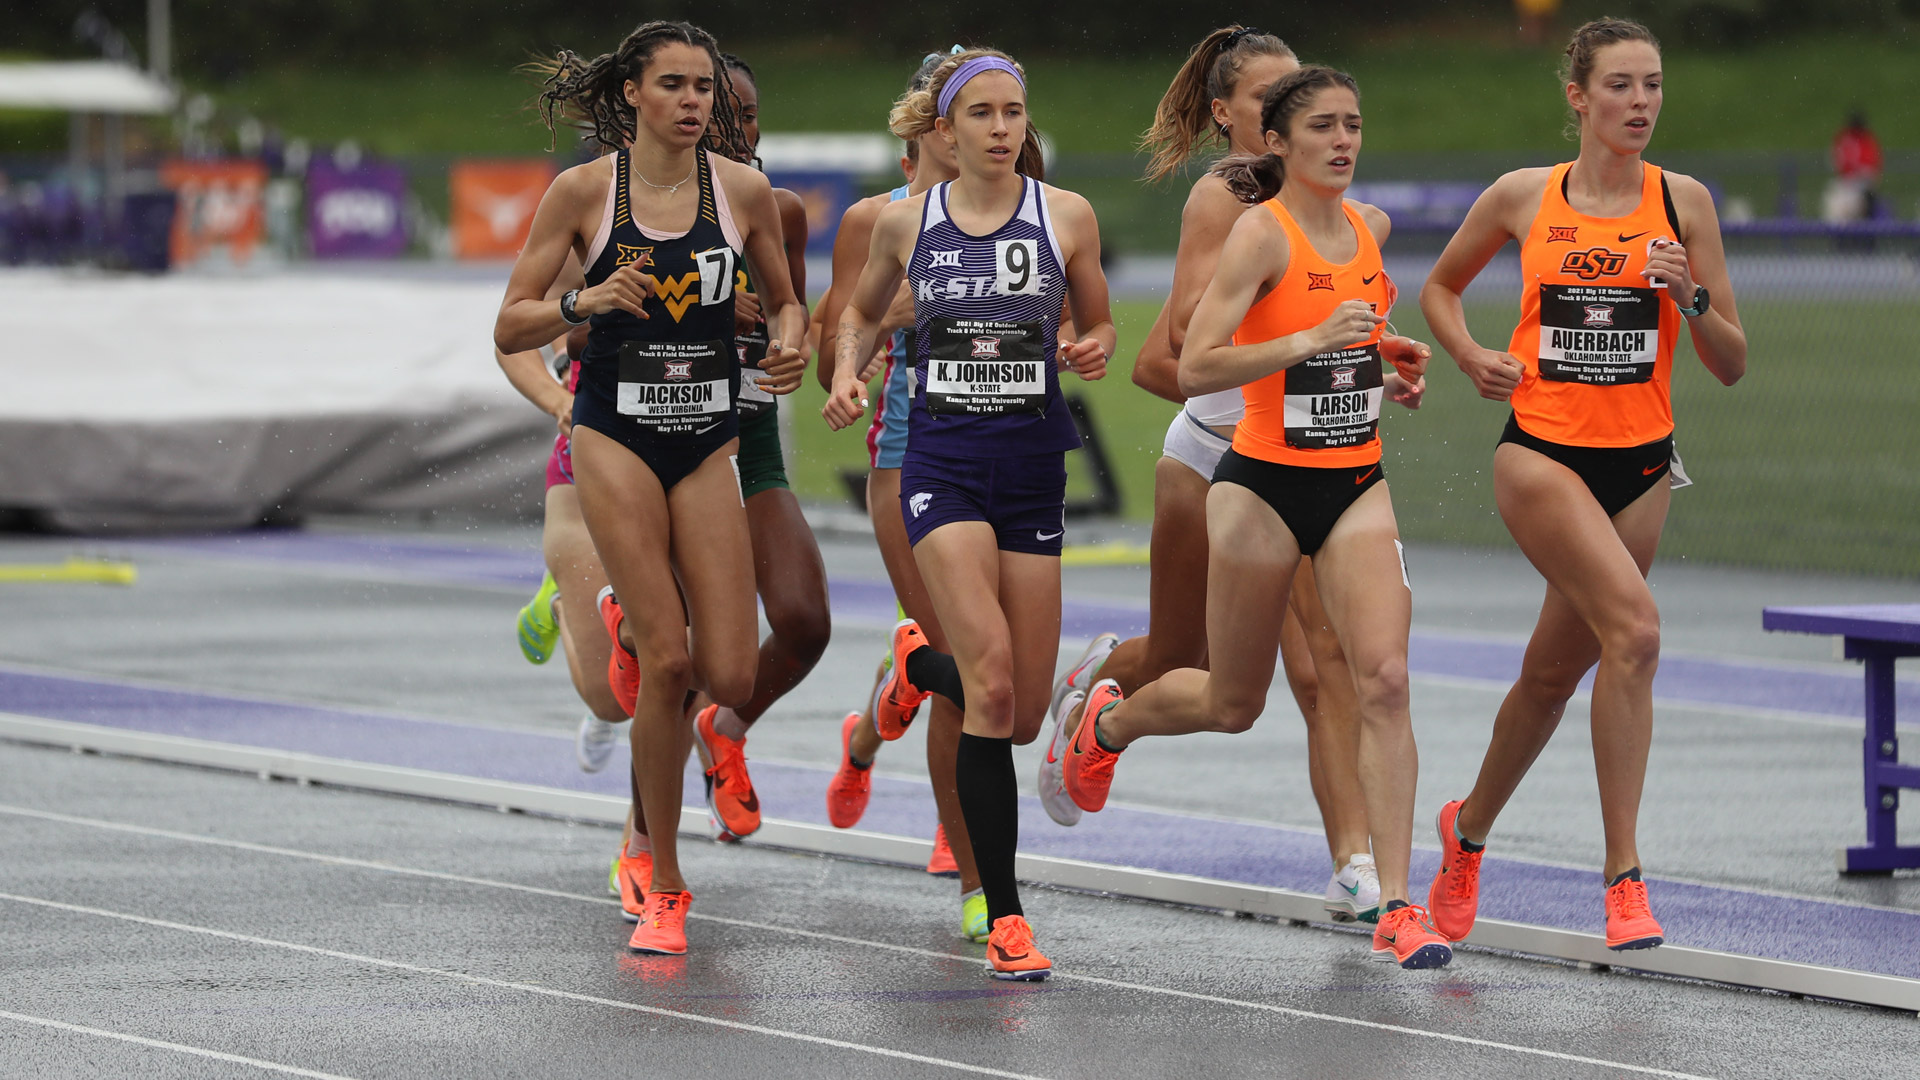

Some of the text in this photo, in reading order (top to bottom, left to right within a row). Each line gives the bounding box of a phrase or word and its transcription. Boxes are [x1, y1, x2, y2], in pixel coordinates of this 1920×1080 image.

[1005, 242, 1030, 291] 9
[1560, 247, 1630, 281] OSU
[705, 252, 727, 301] 7
[918, 274, 1051, 302] K-STE
[1551, 329, 1646, 352] AUERBACH
[678, 350, 716, 358] Championship
[1332, 351, 1340, 359] Big
[1564, 351, 1632, 363] OKLAHOMA STATE
[937, 362, 1037, 383] K. JOHNSON
[1557, 363, 1581, 372] Kansas
[1603, 366, 1637, 374] University
[1577, 374, 1593, 382] May
[637, 383, 713, 404] JACKSON
[970, 384, 1001, 393] K-STATE
[991, 397, 1026, 405] University
[1310, 391, 1369, 416] LARSON
[648, 404, 704, 414] WEST VIRGINIA
[966, 405, 981, 413] May
[1312, 412, 1368, 427] OKLAHOMA STATE
[657, 425, 671, 433] May
